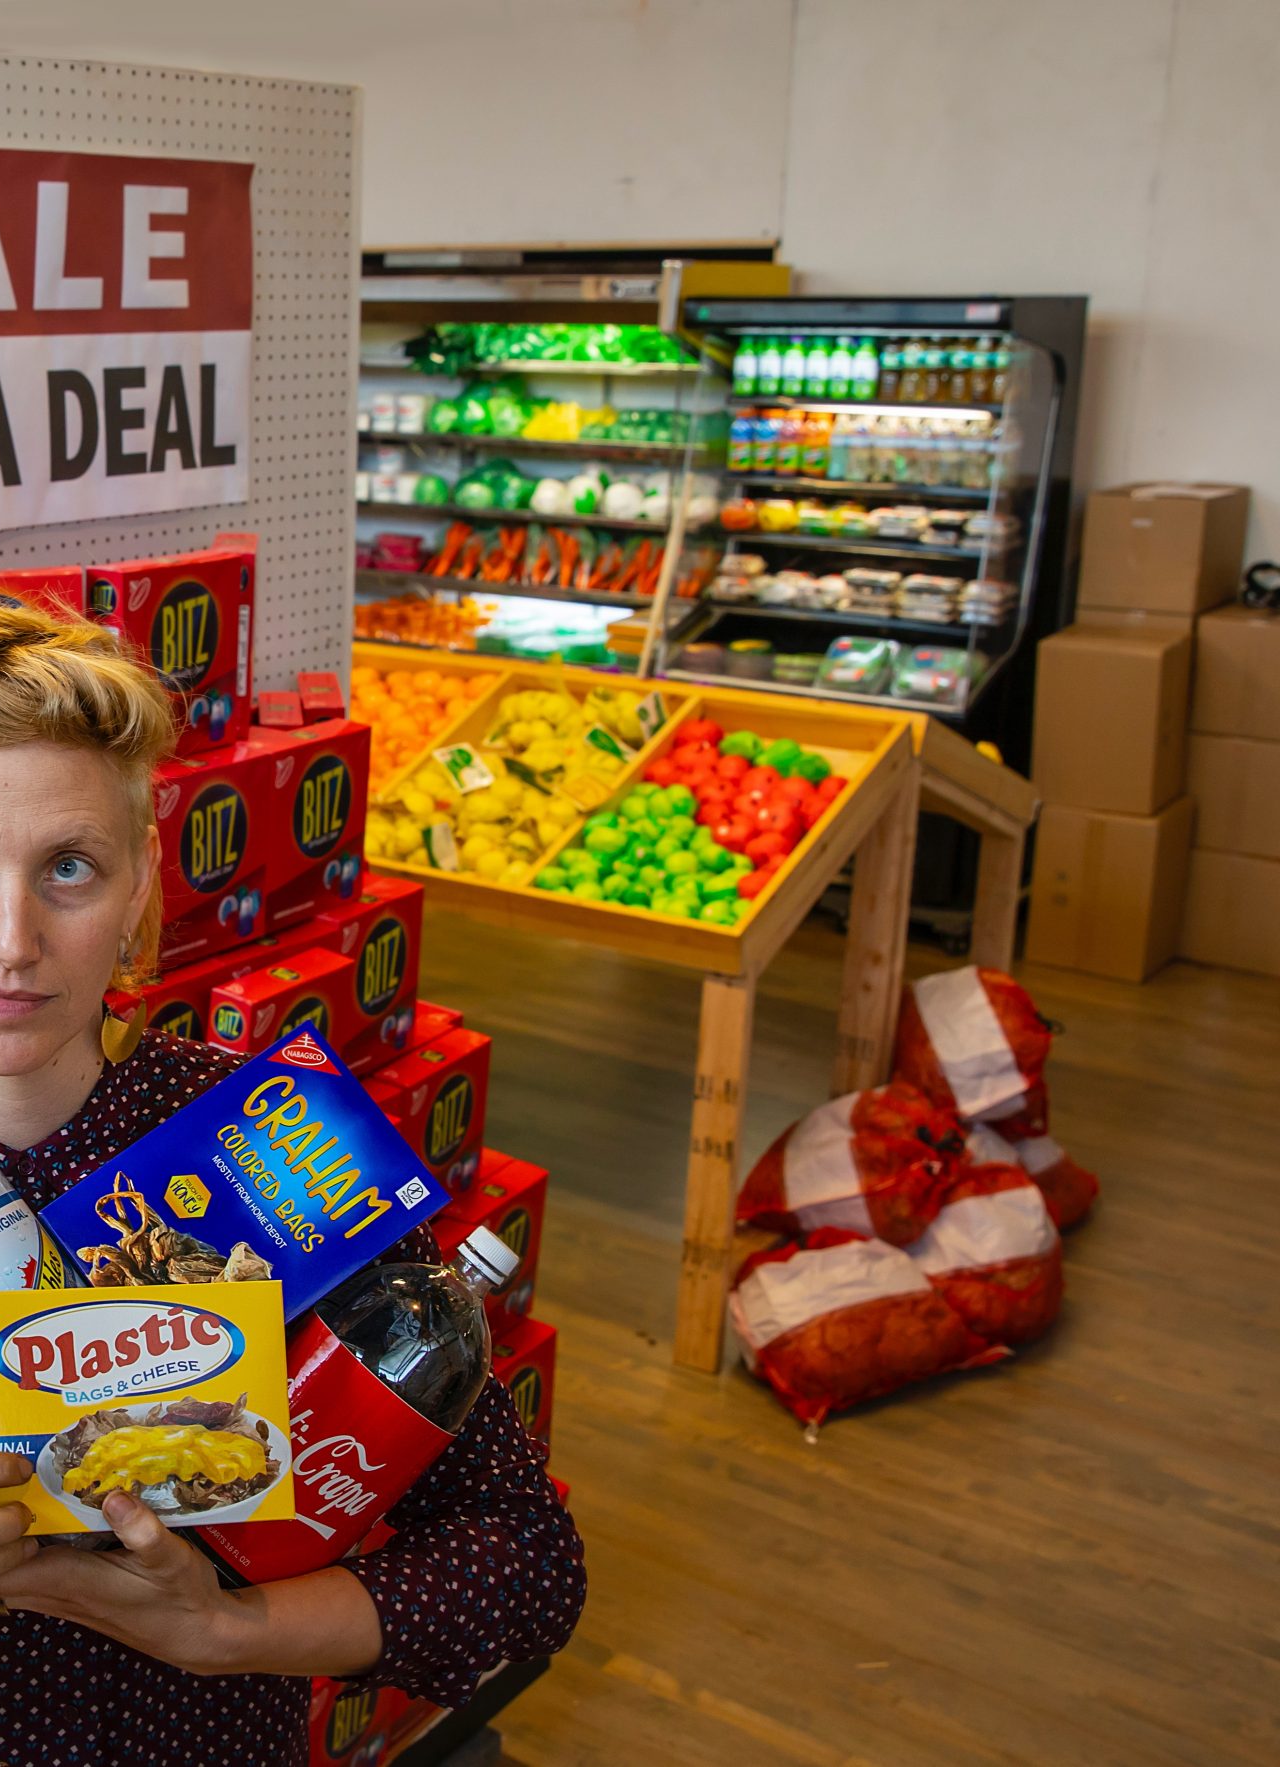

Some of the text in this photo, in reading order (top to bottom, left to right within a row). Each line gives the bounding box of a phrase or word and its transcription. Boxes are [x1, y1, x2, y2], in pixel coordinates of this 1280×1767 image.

[47, 364, 236, 482] DEAL
[162, 594, 209, 676] BITZ
[191, 795, 238, 879] BITZ
[301, 765, 344, 844] BITZ
[363, 926, 401, 1005] BITZ
[218, 1008, 240, 1036] BITZ
[287, 1049, 322, 1061] NABAGSCO
[242, 1075, 393, 1240] GRAHAM
[431, 1080, 468, 1157] BITZ
[170, 1180, 202, 1214] HONEY
[212, 1155, 288, 1249] MOSTLY FROM HOME DEPOT
[217, 1124, 325, 1254] COLORED BAGS
[41, 1250, 61, 1289] bles
[12, 1307, 221, 1391] Plastic
[65, 1360, 200, 1404] BAGS & CHEESE
